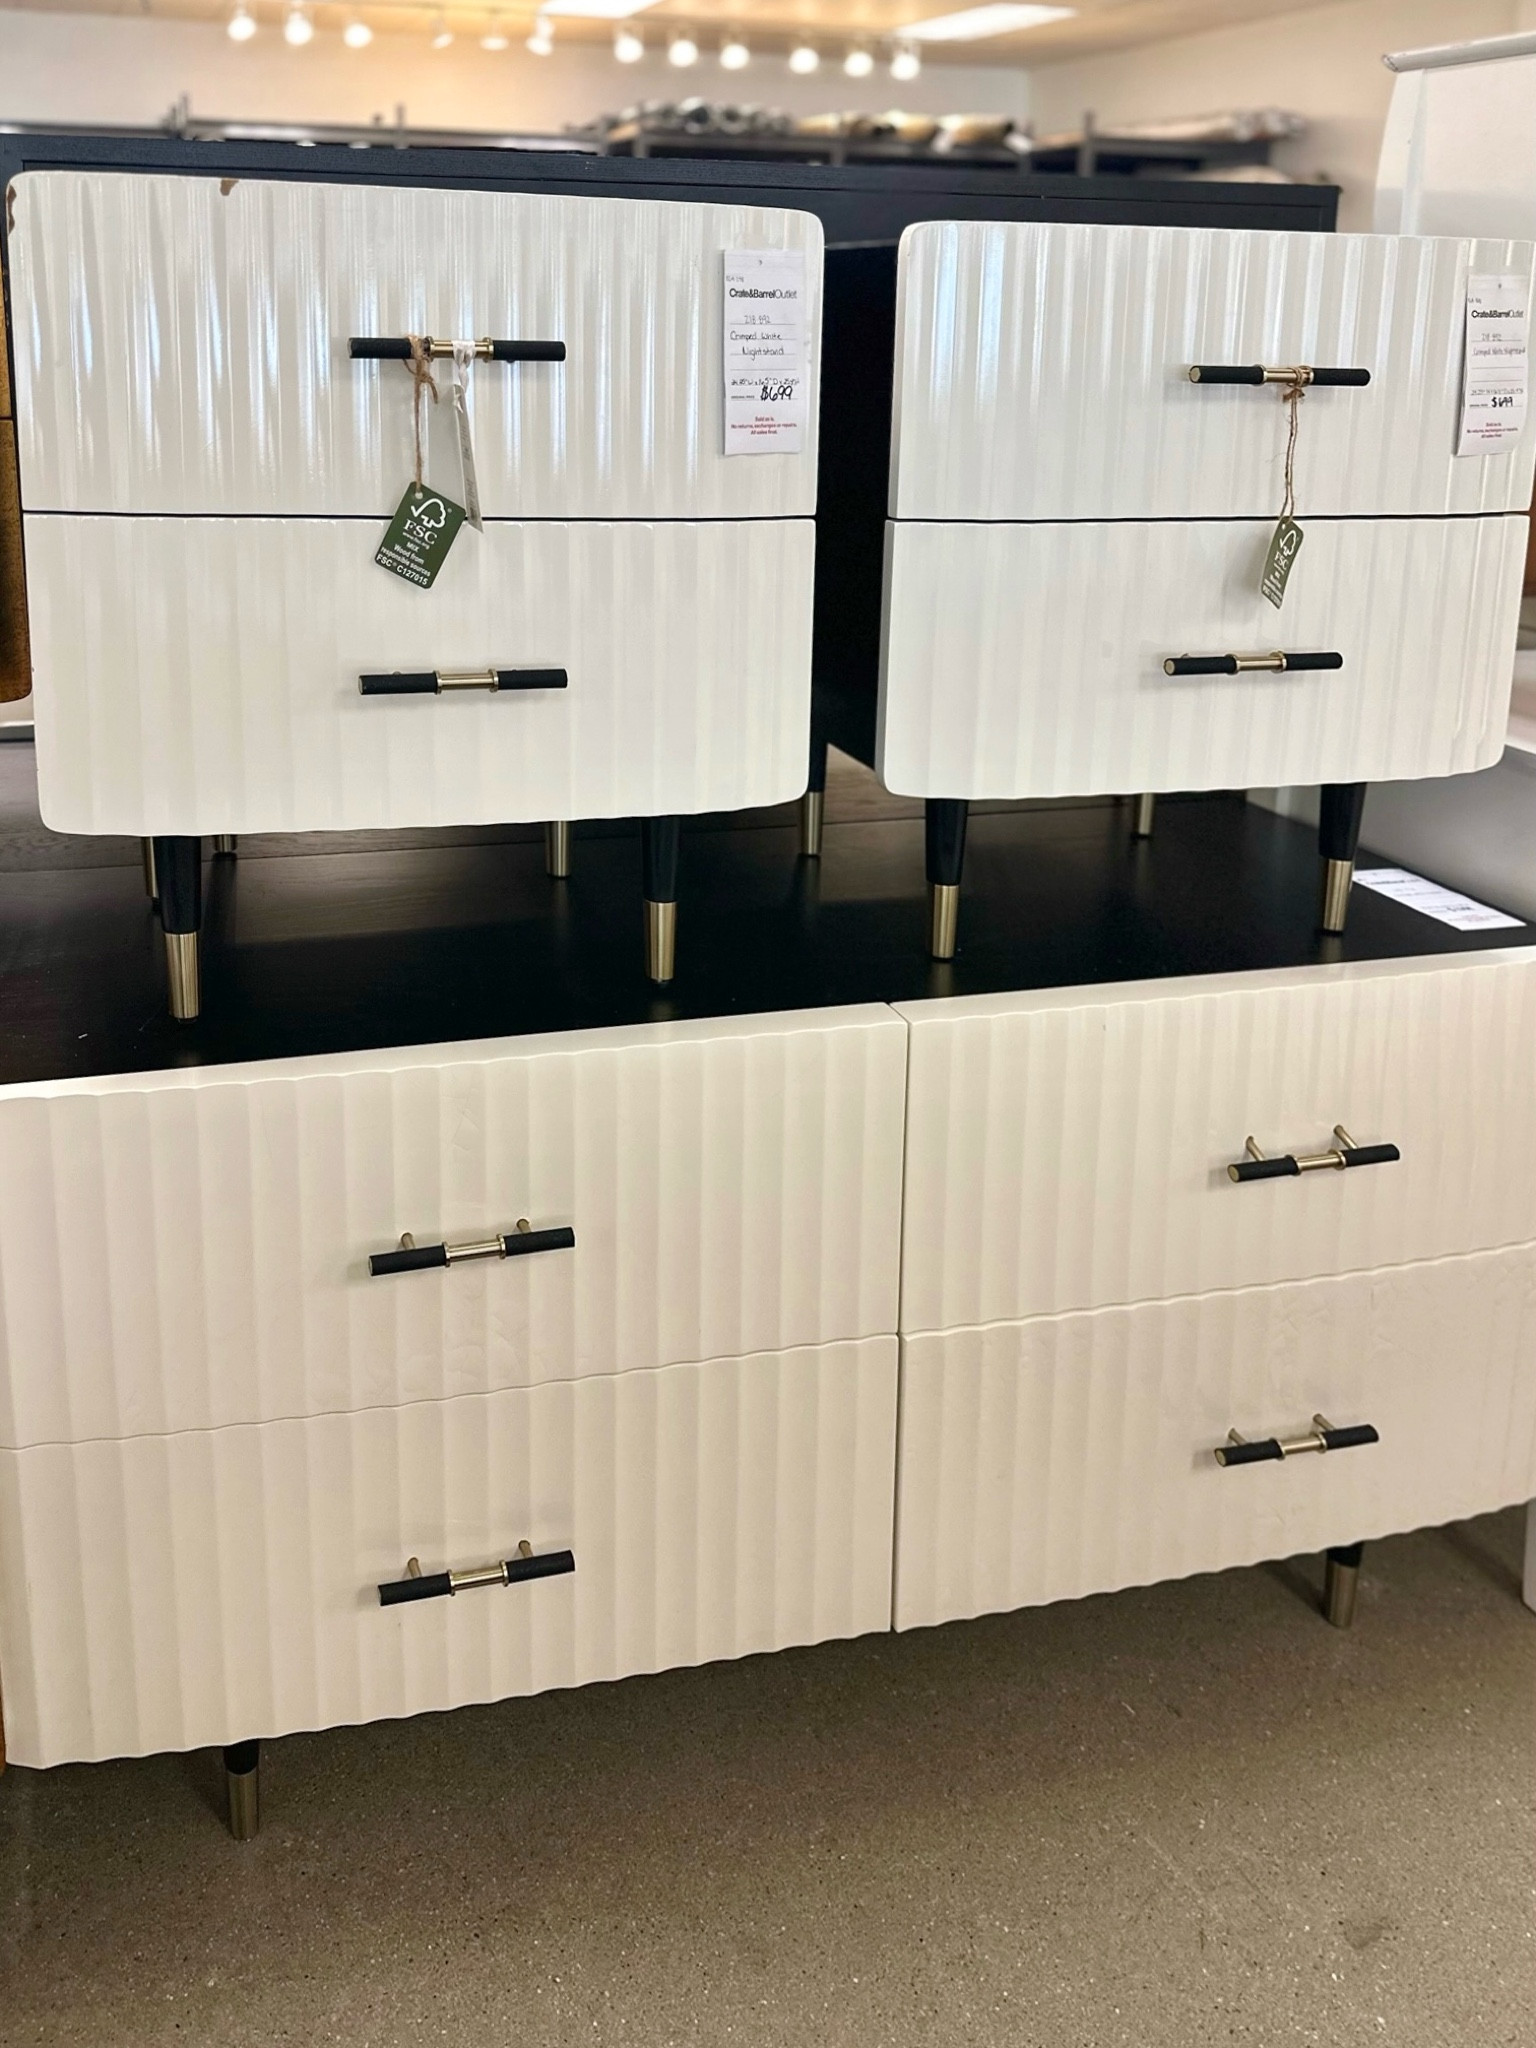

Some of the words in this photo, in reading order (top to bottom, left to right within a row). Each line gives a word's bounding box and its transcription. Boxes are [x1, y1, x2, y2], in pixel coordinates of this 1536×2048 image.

[760, 385, 793, 401] $699
[403, 518, 438, 545] FSC
[393, 544, 411, 557] Wood
[410, 553, 425, 565] from
[406, 541, 420, 553] MIX
[380, 546, 410, 566] responsible
[410, 563, 431, 577] sources
[396, 565, 429, 585] C127015
